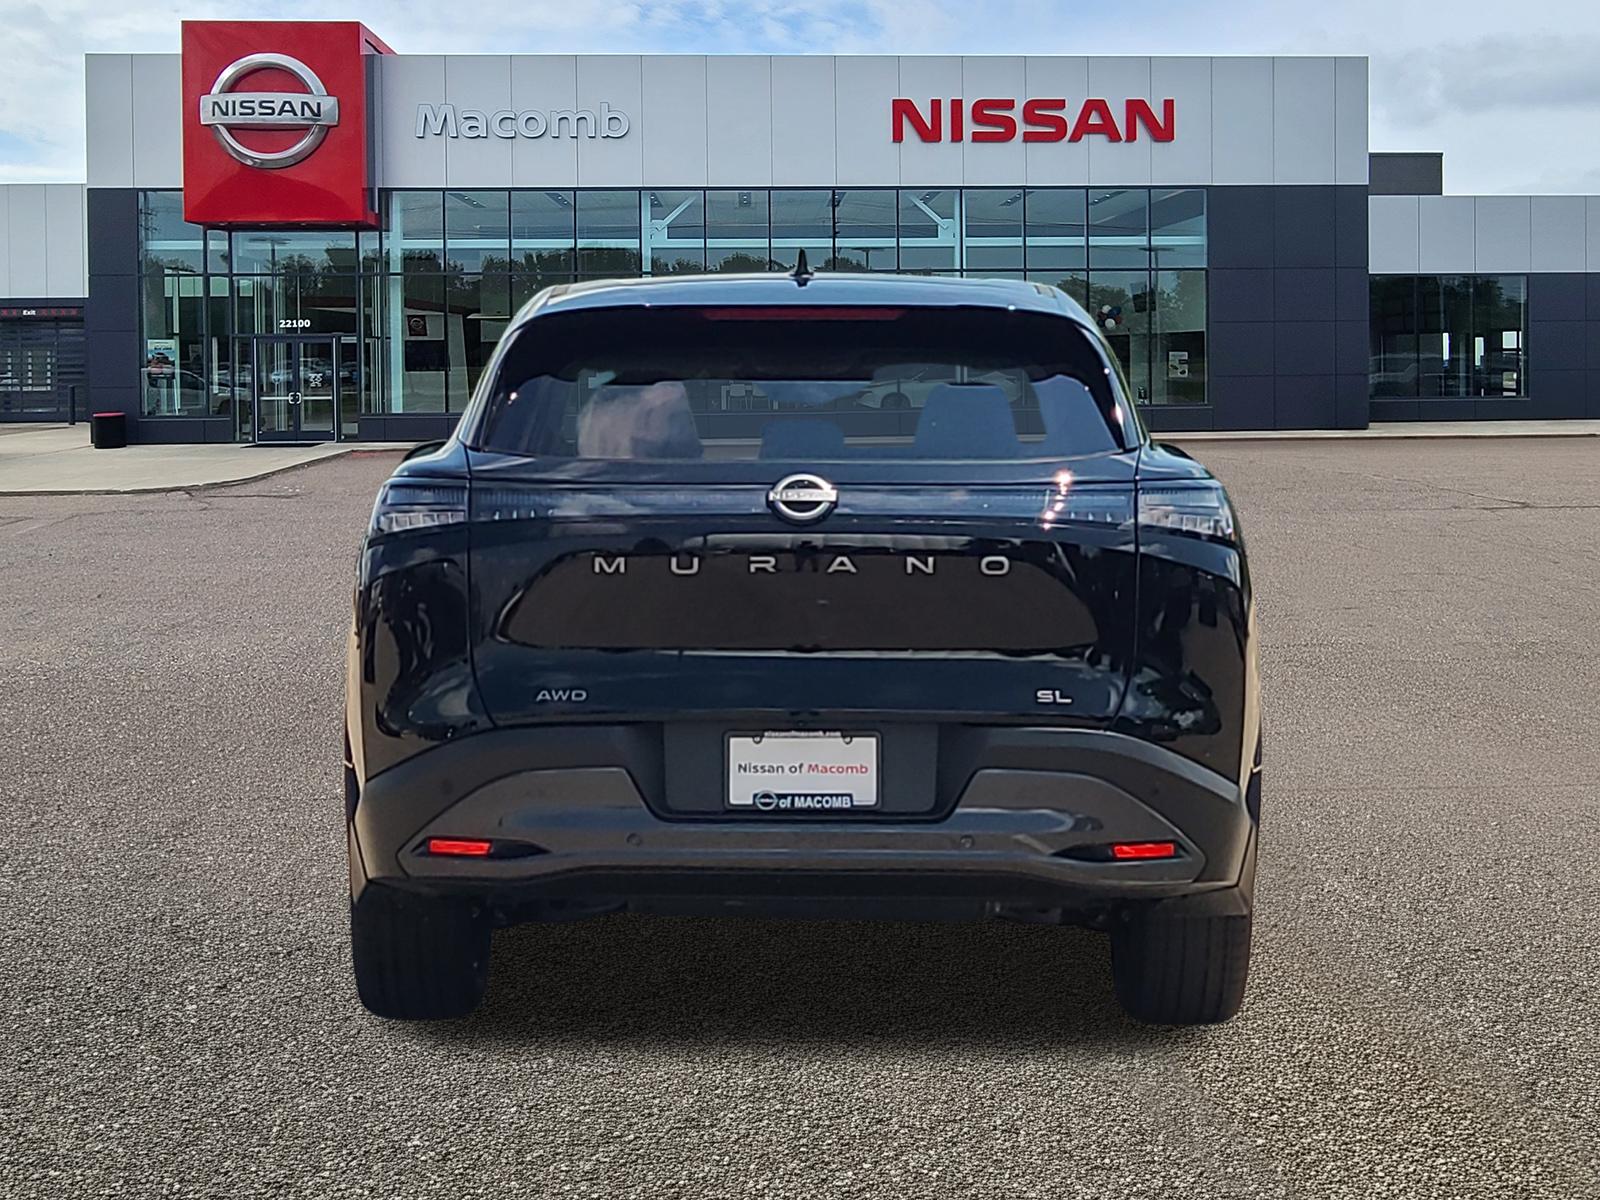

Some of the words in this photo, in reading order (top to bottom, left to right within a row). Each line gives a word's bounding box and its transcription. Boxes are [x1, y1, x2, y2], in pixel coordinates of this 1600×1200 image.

[211, 100, 322, 118] NISSAN
[415, 102, 630, 139] Macomb
[892, 98, 1175, 143] NISSAN
[279, 319, 311, 328] 22100
[593, 556, 1011, 575] MURANO
[535, 689, 588, 702] AWD
[1036, 690, 1073, 703] SL
[737, 763, 785, 774] Nissan
[788, 763, 804, 774] of
[807, 763, 869, 775] Macomb
[778, 796, 792, 808] of
[794, 796, 852, 808] MACOMB
